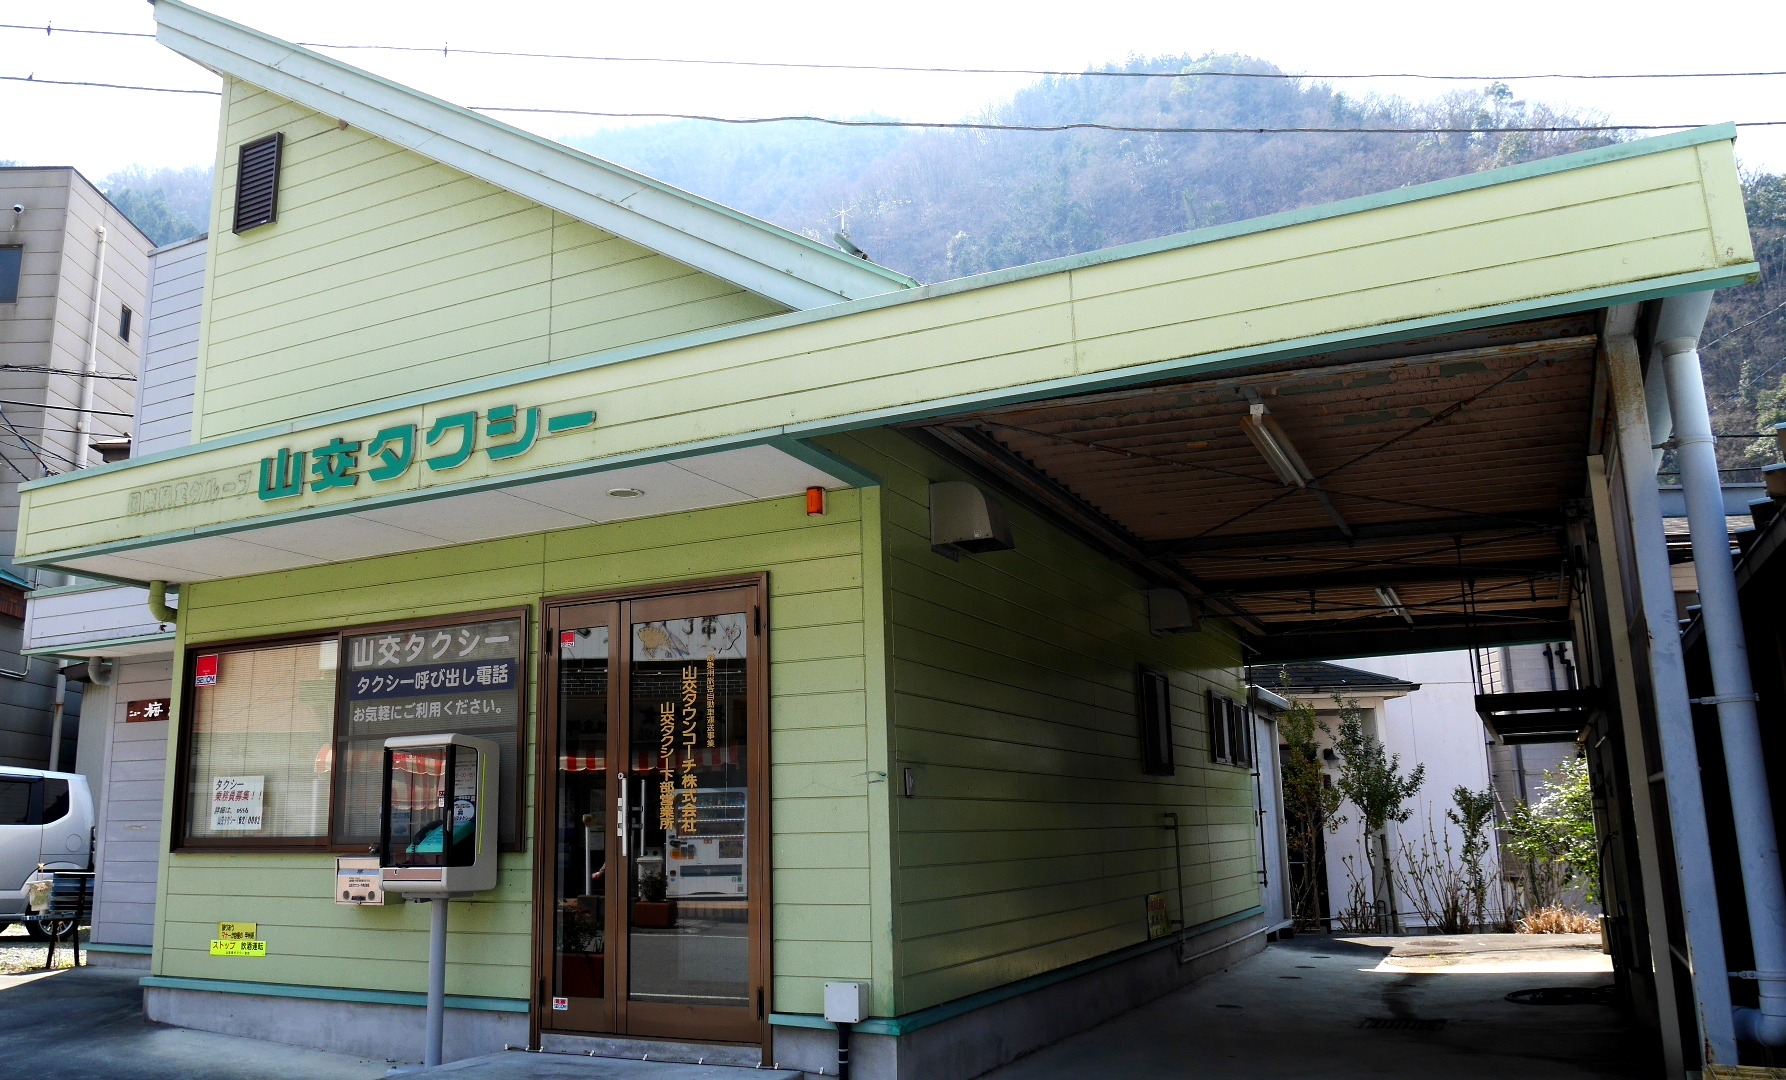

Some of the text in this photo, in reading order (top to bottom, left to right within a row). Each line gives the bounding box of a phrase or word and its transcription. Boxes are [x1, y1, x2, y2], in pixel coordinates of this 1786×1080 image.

[258, 404, 597, 501] 山交タクシー
[354, 629, 510, 667] 山交タクシー
[357, 664, 509, 695] タクシー呼び出し電話
[353, 699, 502, 723] お気軽にご利用ください。
[682, 665, 698, 833] 山交タウンコーチ株式会社
[660, 702, 675, 831] 山交タクシー下部営業所
[215, 779, 244, 791] タクシー
[212, 941, 237, 950] ストップ
